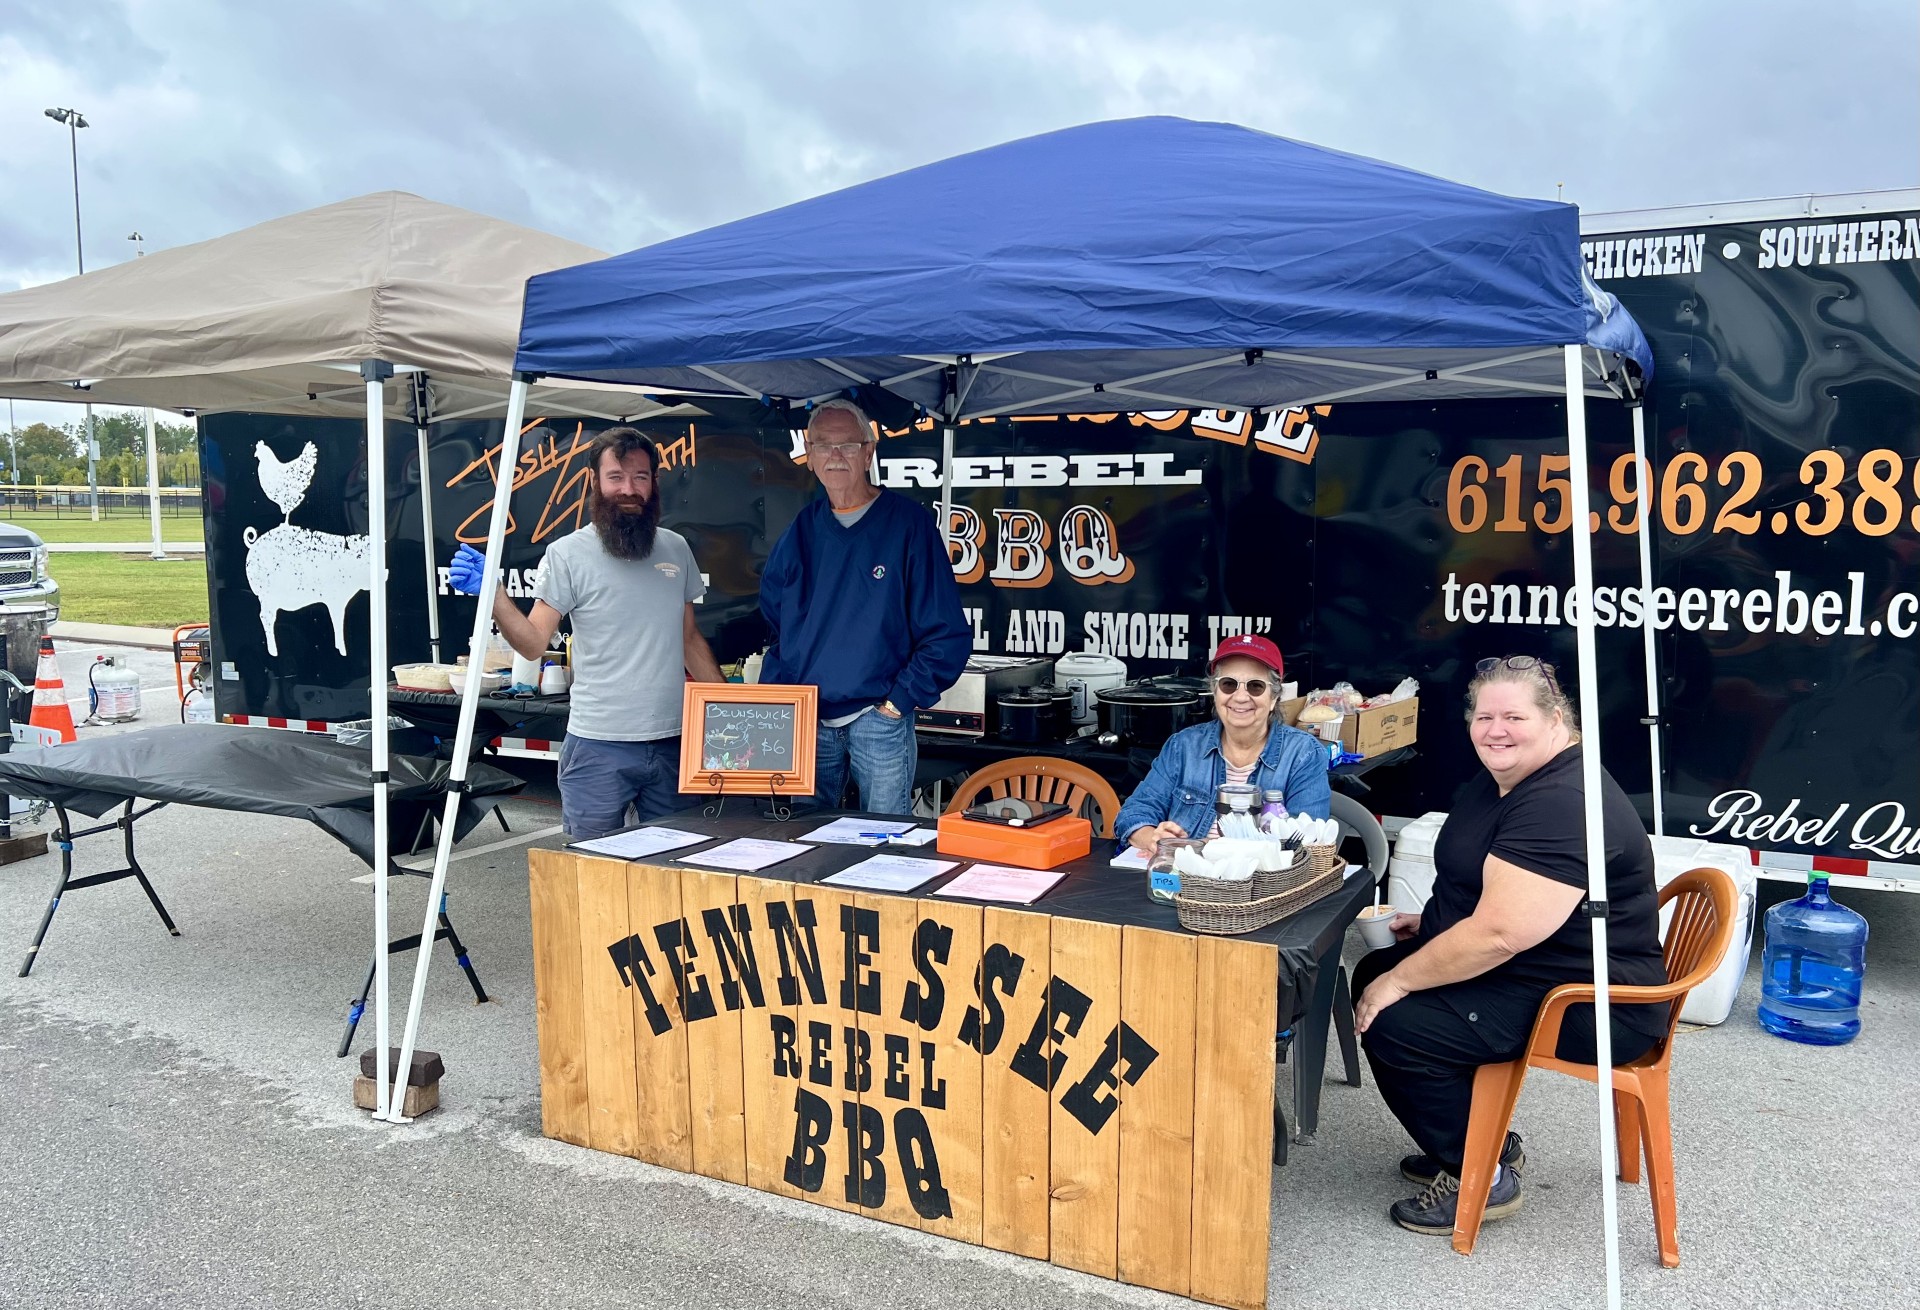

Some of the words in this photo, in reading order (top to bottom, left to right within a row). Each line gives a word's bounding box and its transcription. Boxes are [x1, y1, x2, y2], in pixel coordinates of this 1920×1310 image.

[1580, 234, 1705, 279] CHICKEN
[1758, 218, 1920, 269] SOUTHERN
[880, 453, 1202, 487] REBEL
[1447, 449, 1920, 537] 615.962.38
[933, 501, 1136, 588] BBQ
[1005, 609, 1065, 654] AND
[1083, 610, 1189, 660] SMOKE
[758, 721, 785, 730] STEW
[761, 738, 785, 756] $6
[1690, 790, 1849, 846] Rebel
[607, 899, 1159, 1135] TENNESSEE
[771, 1014, 946, 1110] REBEL
[783, 1087, 953, 1220] BBQ
